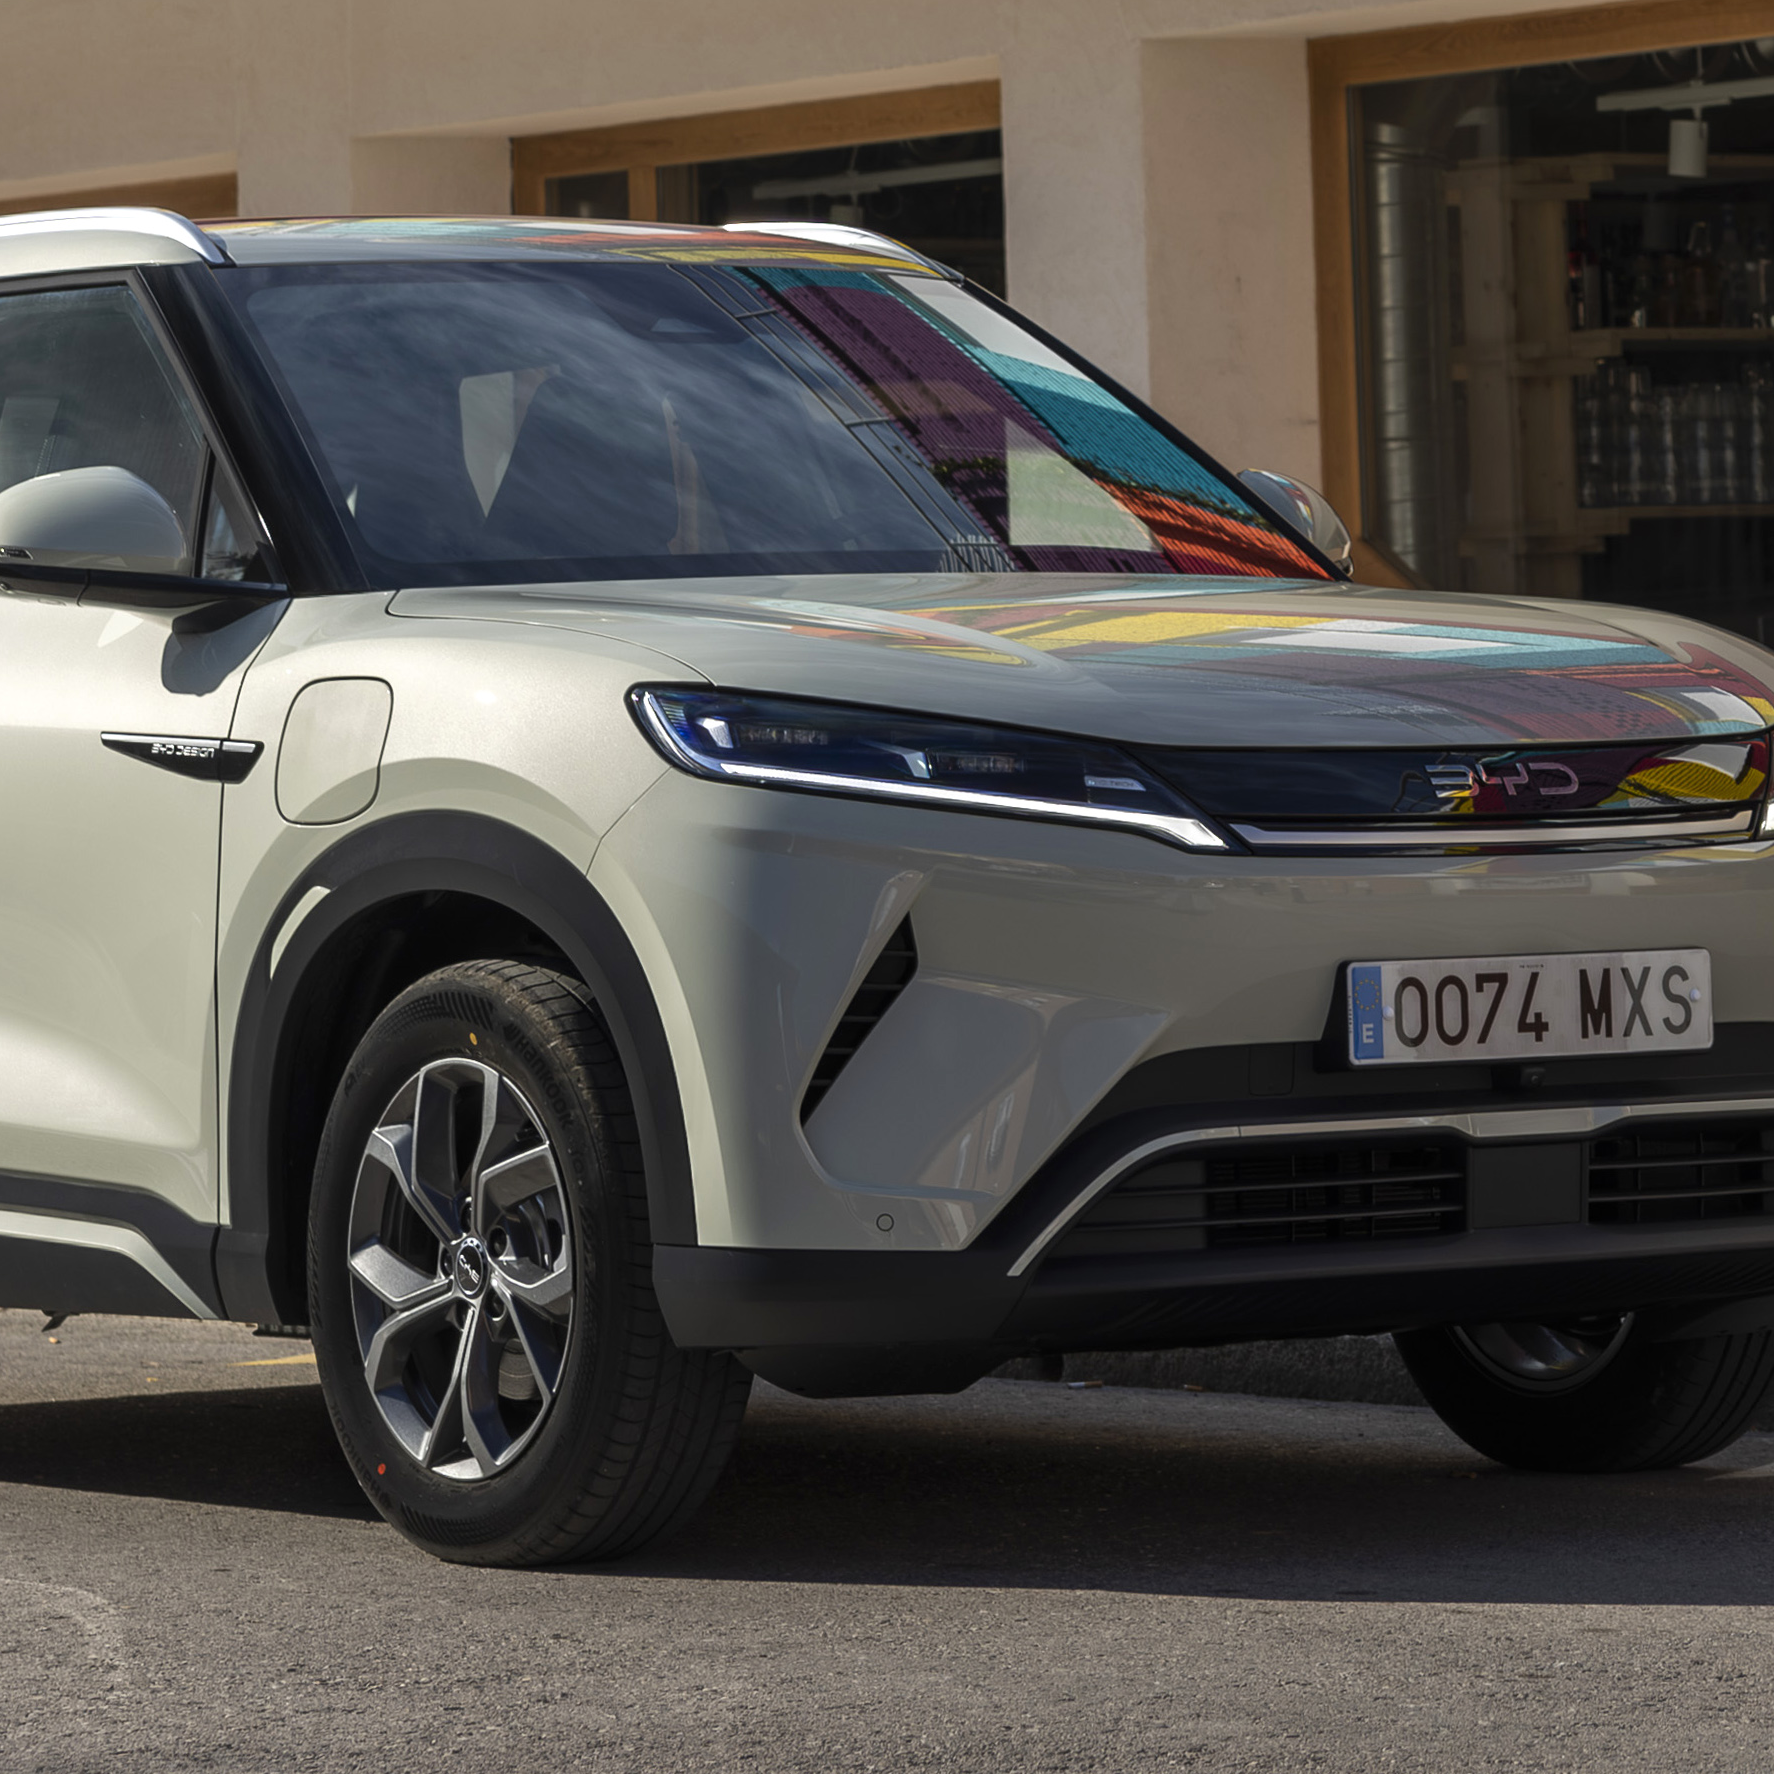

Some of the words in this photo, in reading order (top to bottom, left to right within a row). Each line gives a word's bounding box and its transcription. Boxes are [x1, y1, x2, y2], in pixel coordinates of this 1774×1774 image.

[151, 743, 174, 755] BYD
[176, 745, 215, 758] DESIGN
[1424, 762, 1579, 798] BYD
[1394, 971, 1550, 1048] 0074
[1578, 964, 1693, 1040] MXS
[1362, 1023, 1375, 1044] E
[513, 1034, 574, 1131] Hankook
